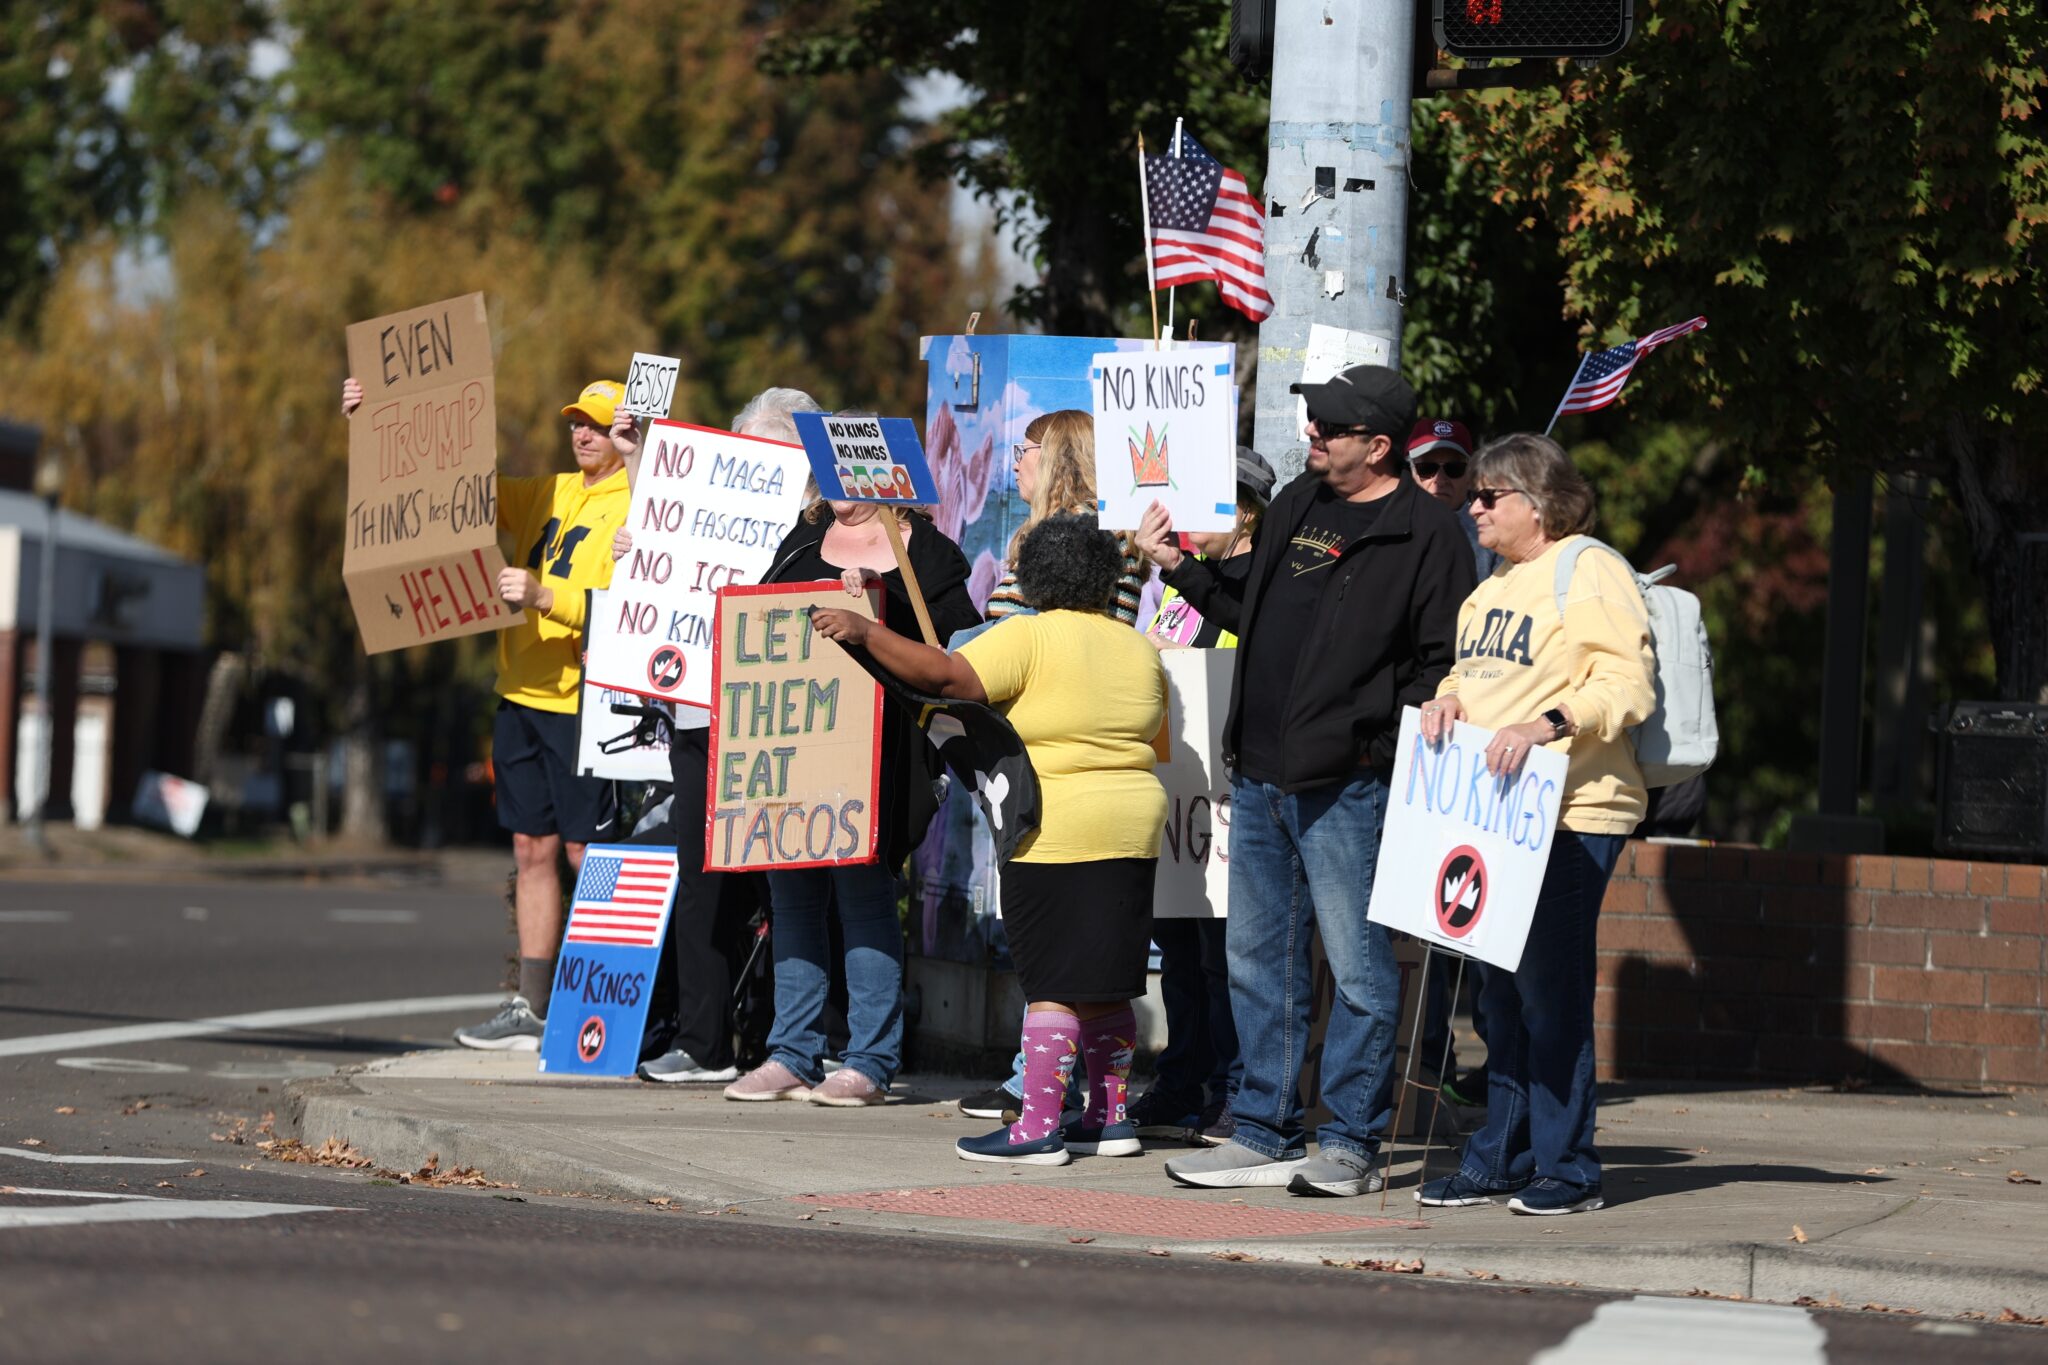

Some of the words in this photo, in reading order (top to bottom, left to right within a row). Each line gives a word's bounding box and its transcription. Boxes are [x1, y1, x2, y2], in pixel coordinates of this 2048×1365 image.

[380, 312, 454, 387] EVEN
[625, 360, 678, 416] RESIST
[1103, 366, 1135, 411] NO
[1145, 363, 1205, 410] KINGS
[372, 381, 485, 483] TRUMP
[828, 422, 844, 437] NO
[845, 422, 879, 438] KINGS
[836, 444, 852, 458] NO
[852, 444, 887, 460] KINGS
[653, 438, 695, 479] NO
[708, 452, 784, 496] MAGA
[350, 489, 424, 550] THINKS
[451, 470, 496, 534] GOING
[642, 497, 684, 533] NO
[690, 508, 789, 551] FASCISTS
[527, 517, 592, 579] M
[630, 548, 673, 584] NO
[400, 549, 500, 638] HELL!
[617, 600, 658, 635] NO
[666, 610, 715, 649] KIN
[735, 606, 817, 665] LET
[723, 678, 841, 739] THEM
[719, 746, 797, 802] EAT
[1406, 733, 1461, 815] NO
[1464, 754, 1555, 851] KINGS
[715, 800, 864, 865] TACOS
[557, 955, 584, 992] NO
[582, 960, 645, 1007] KINGS
